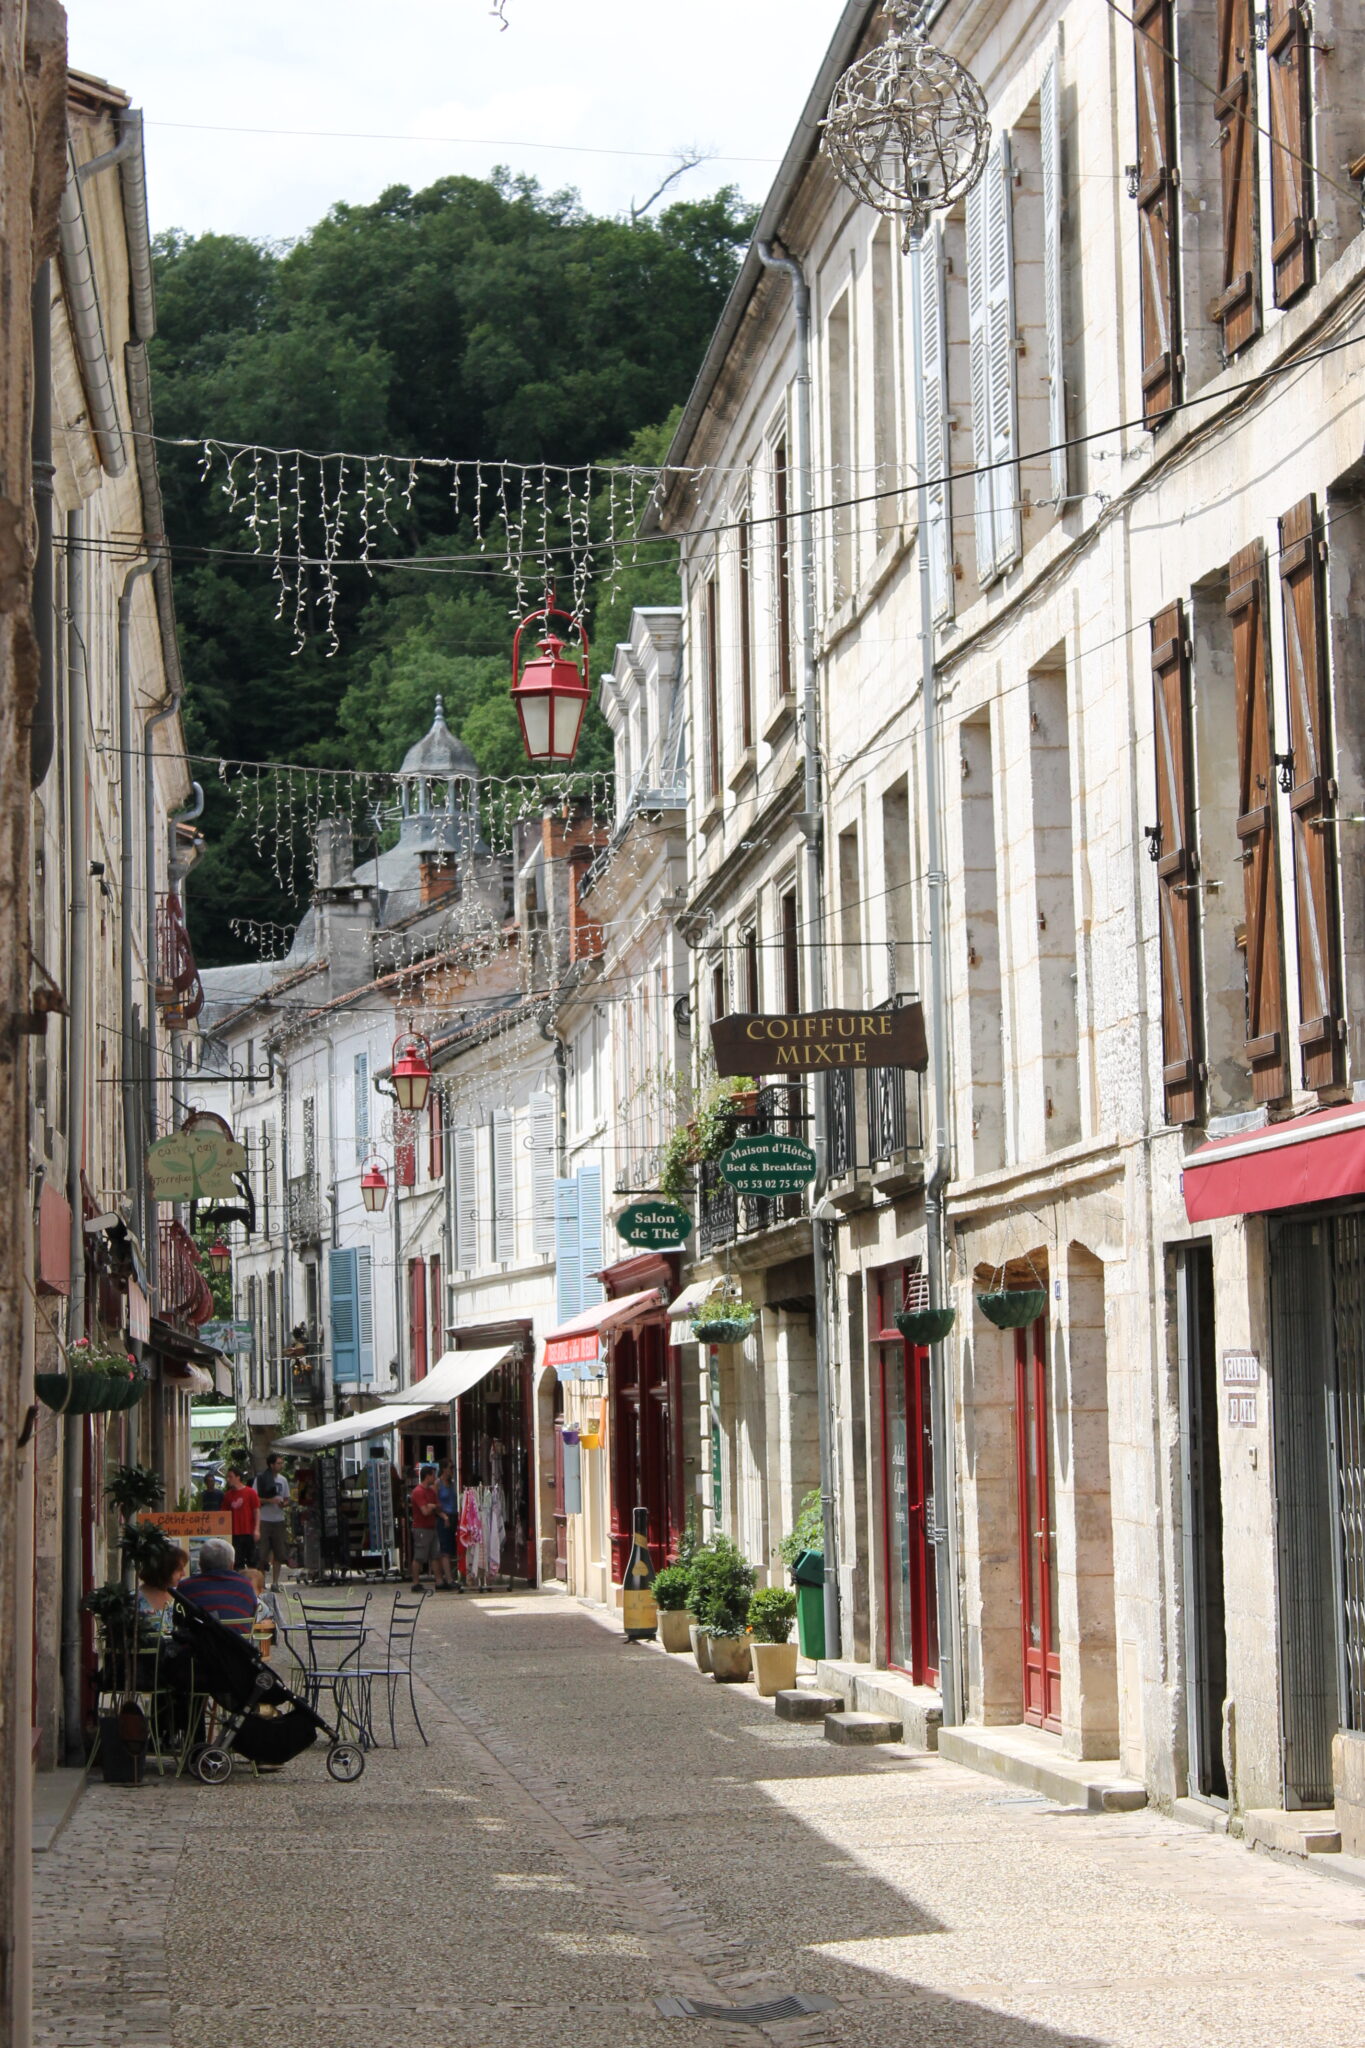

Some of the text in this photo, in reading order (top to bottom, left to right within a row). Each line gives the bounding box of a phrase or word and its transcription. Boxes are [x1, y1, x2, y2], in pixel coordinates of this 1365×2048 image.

[746, 1015, 893, 1040] COIFFURE
[775, 1041, 867, 1065] MIXTE
[730, 1143, 813, 1161] Maison d'Hôtes
[726, 1163, 813, 1172] Bed & Breakfast
[737, 1179, 805, 1189] 05 53 02 75 49
[634, 1212, 675, 1224] Salon
[630, 1228, 679, 1239] de Thé
